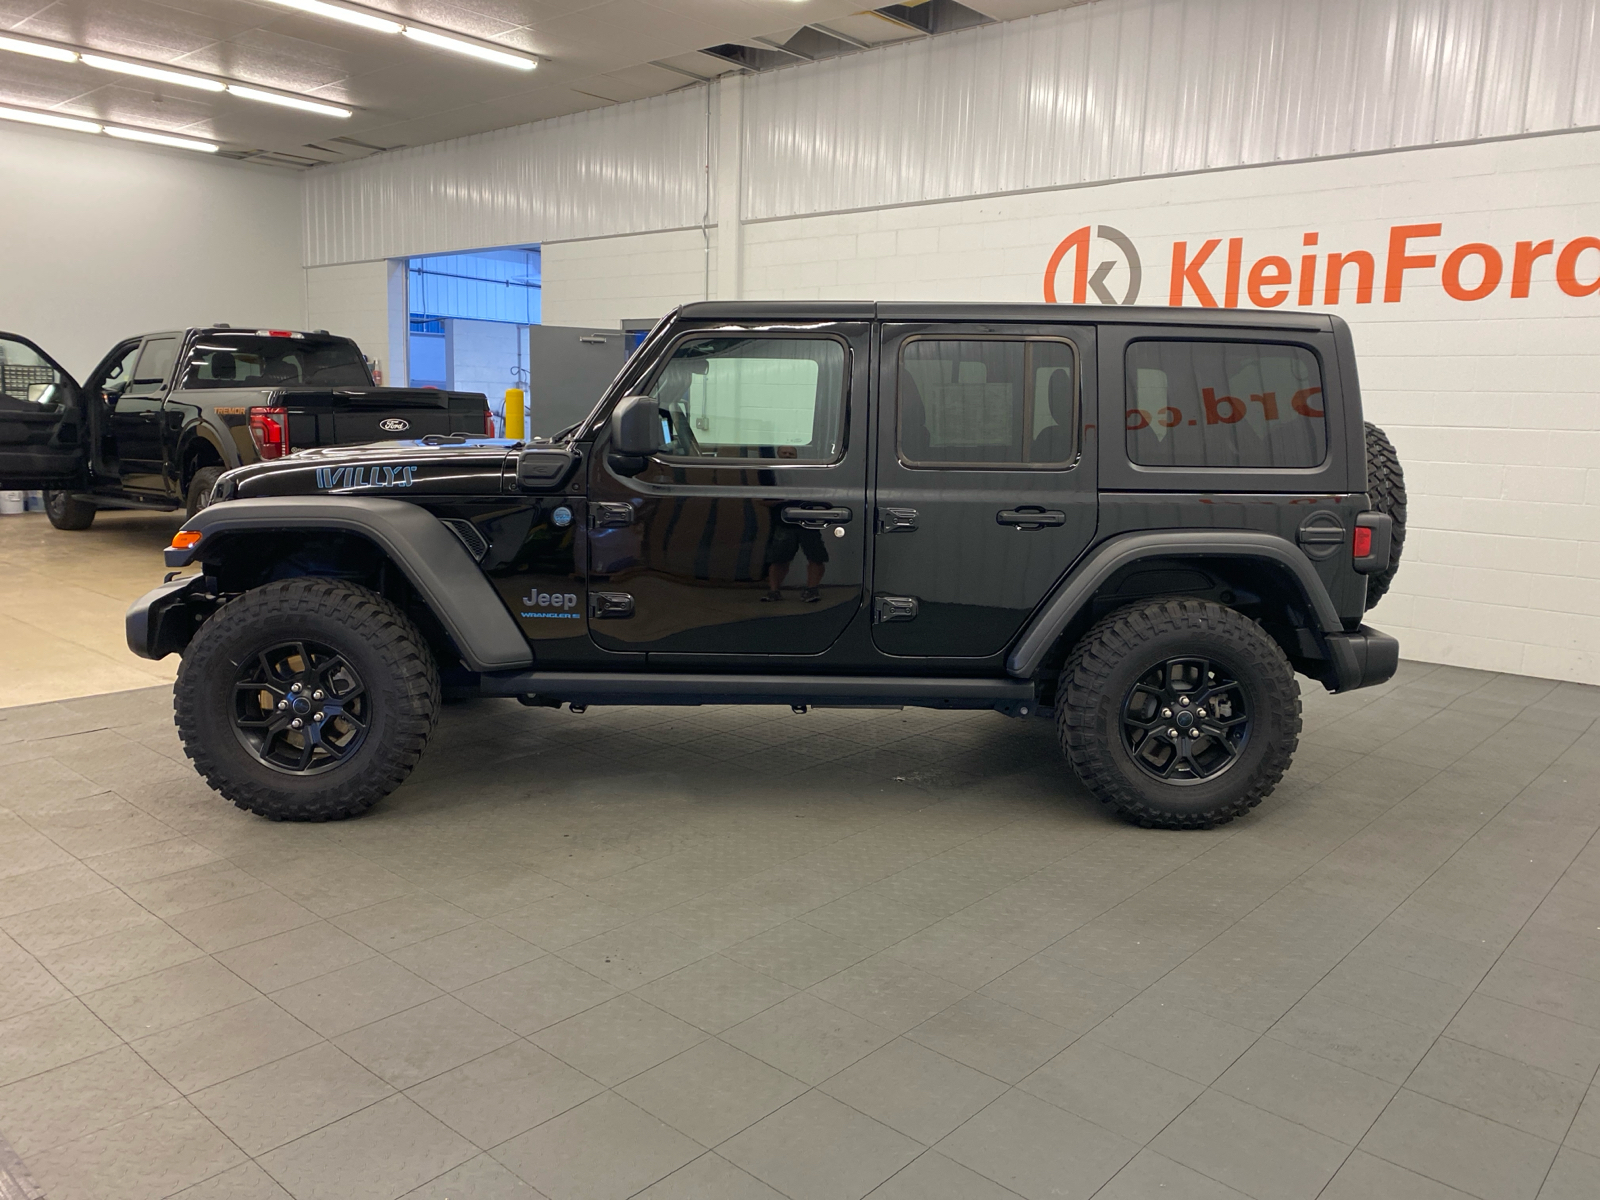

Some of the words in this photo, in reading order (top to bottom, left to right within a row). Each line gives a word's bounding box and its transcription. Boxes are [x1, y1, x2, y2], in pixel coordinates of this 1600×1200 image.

[213, 407, 246, 415] TREMOR
[316, 466, 417, 488] WILLYS
[522, 588, 577, 610] Jeep
